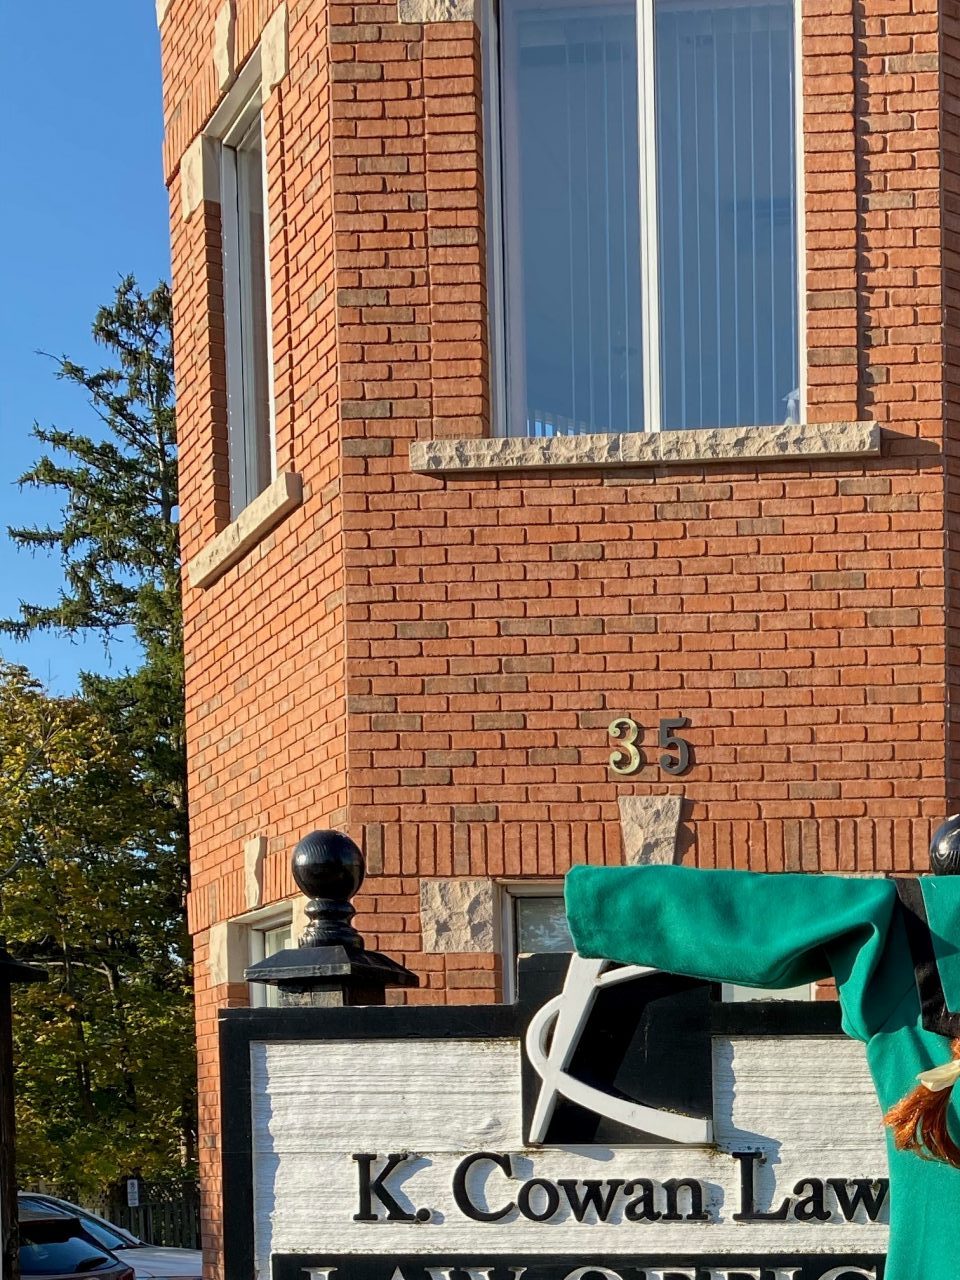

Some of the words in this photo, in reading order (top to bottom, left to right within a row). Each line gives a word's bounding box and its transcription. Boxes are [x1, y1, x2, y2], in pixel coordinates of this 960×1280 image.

[608, 717, 689, 775] 35
[352, 1153, 430, 1222] K.
[453, 1153, 708, 1222] Cowan
[732, 1152, 890, 1221] Law
